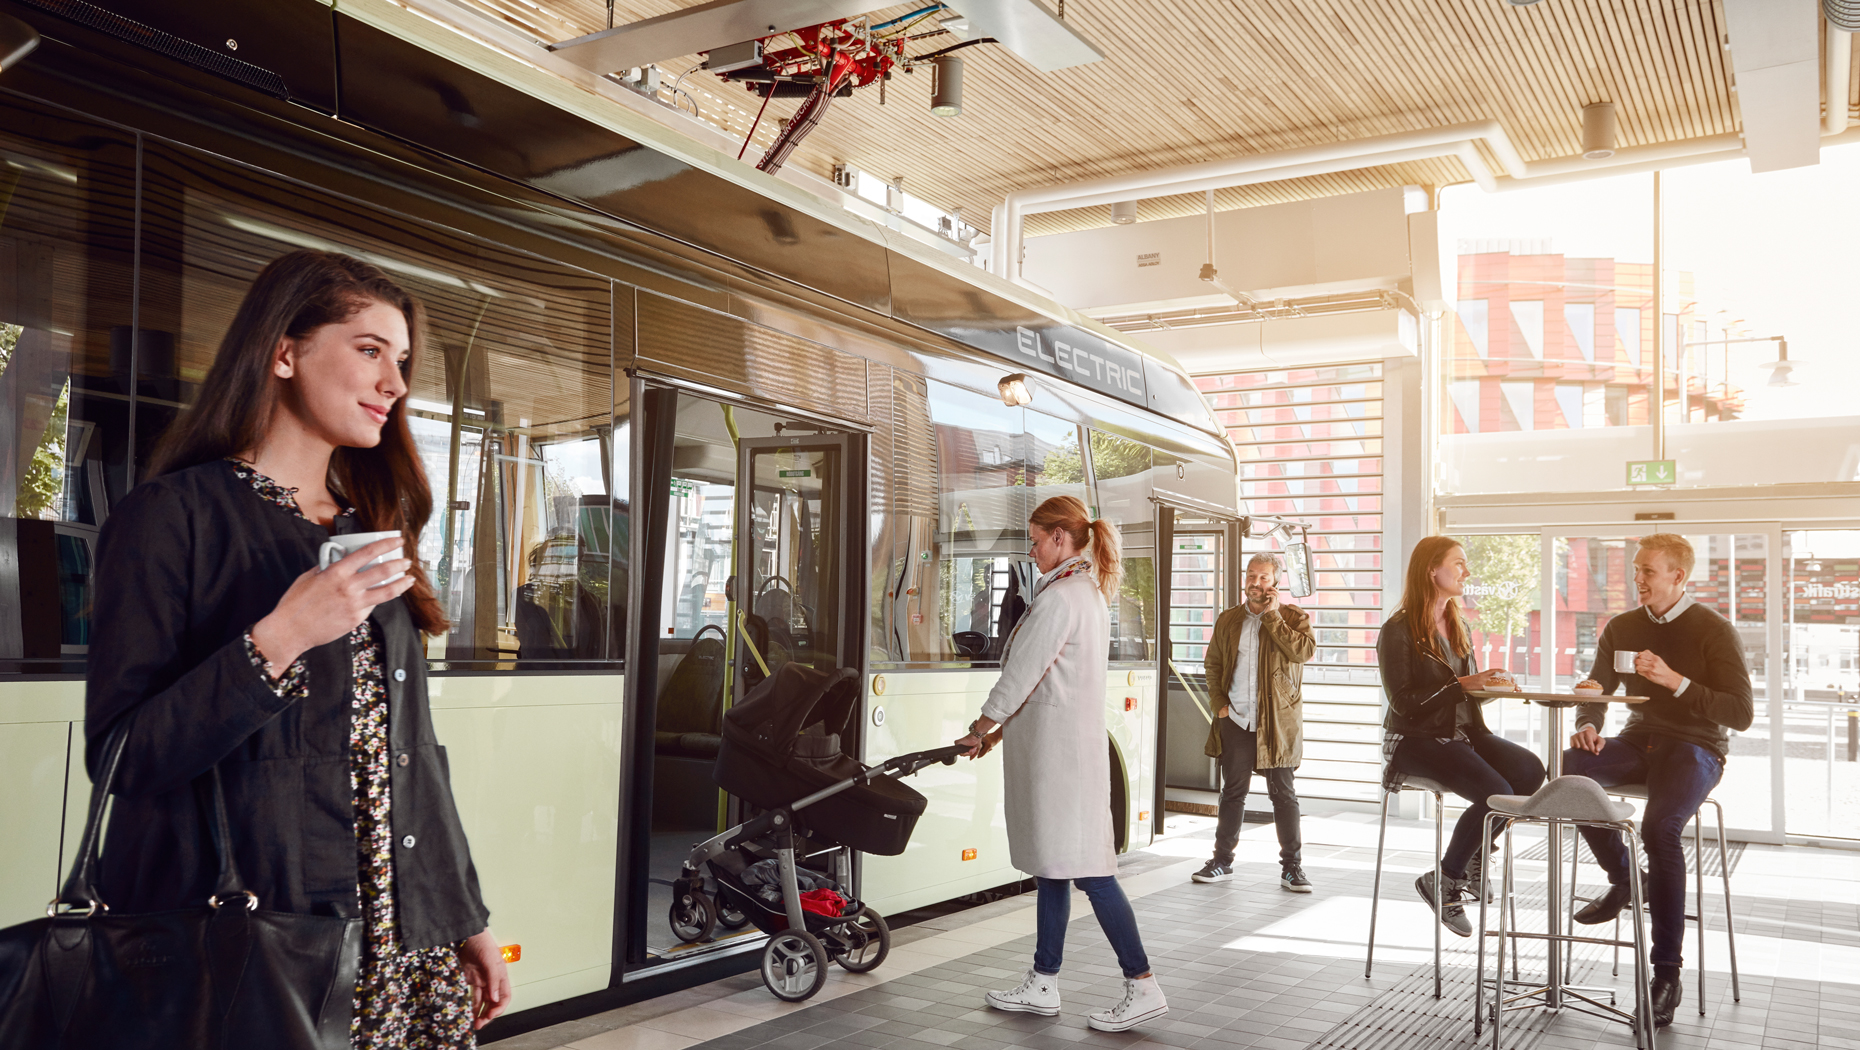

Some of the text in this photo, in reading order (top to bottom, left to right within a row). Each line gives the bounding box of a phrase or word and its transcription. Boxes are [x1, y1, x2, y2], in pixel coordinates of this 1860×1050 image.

[757, 88, 819, 168] STEMMANN-TECHNIK
[1137, 252, 1160, 261] ALBANY
[1016, 325, 1142, 396] ELECTRIC
